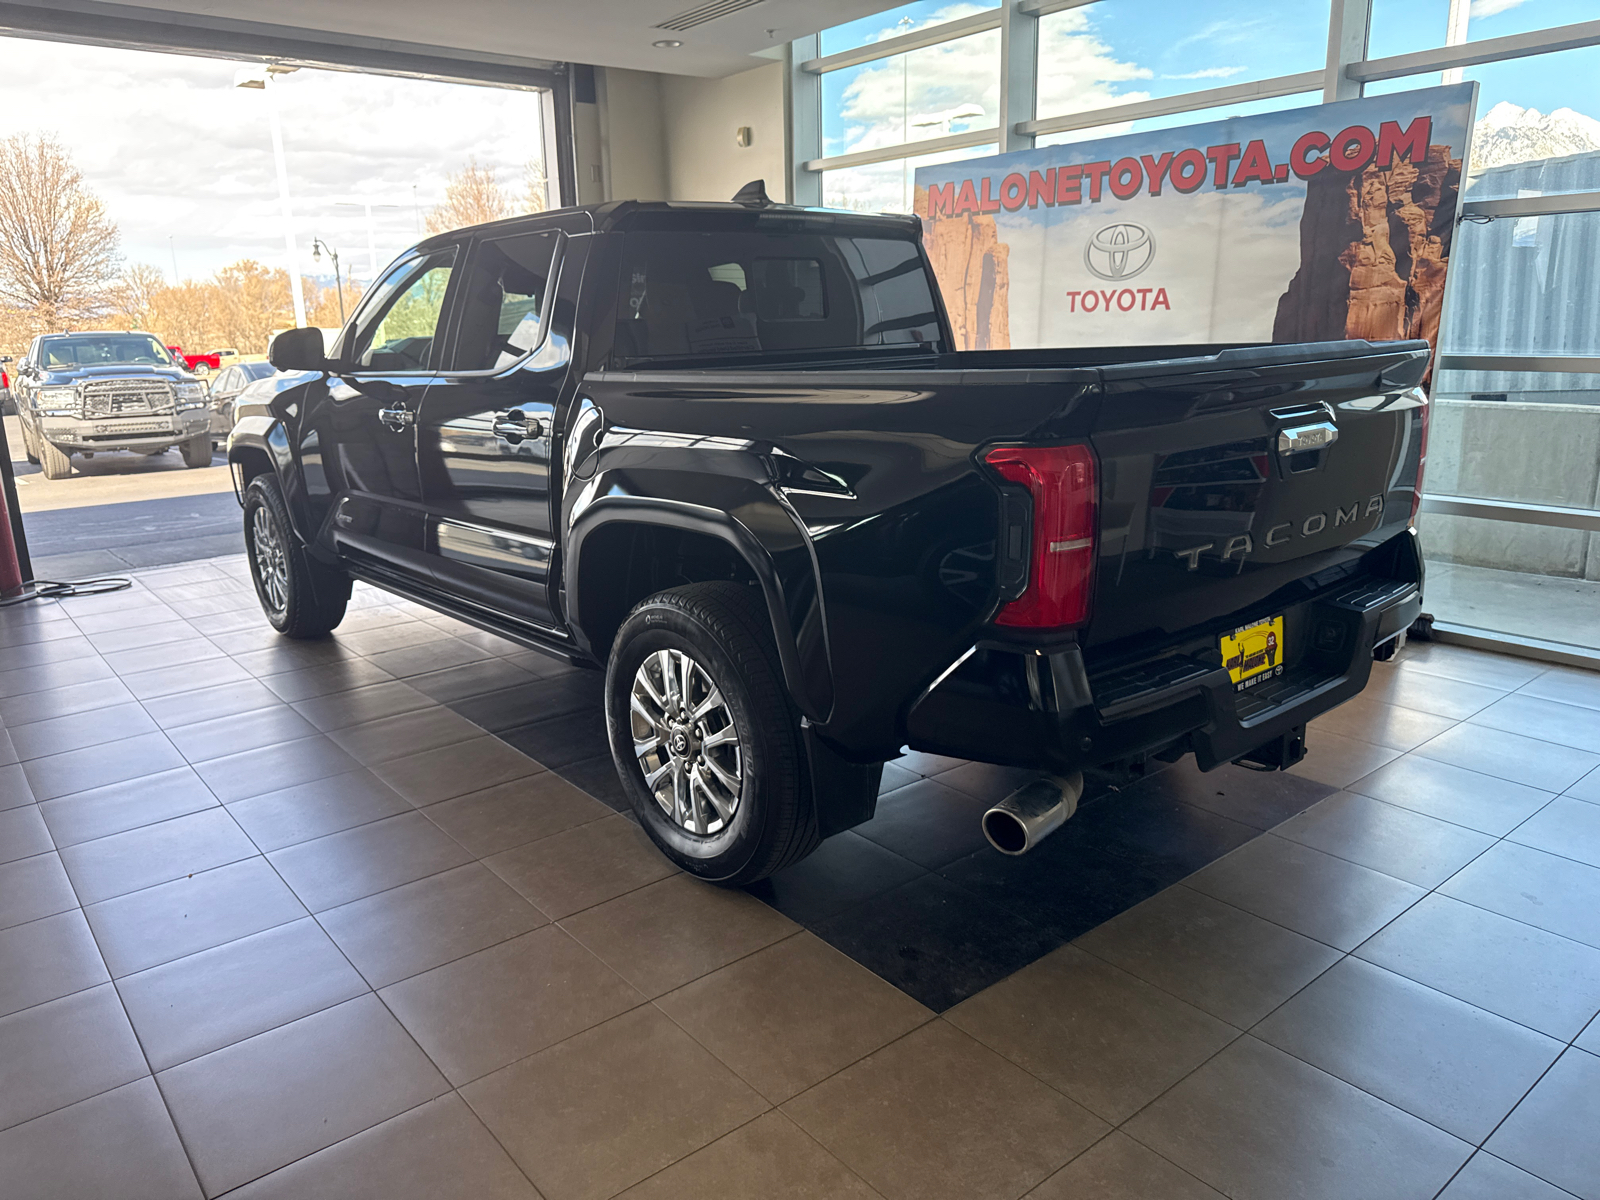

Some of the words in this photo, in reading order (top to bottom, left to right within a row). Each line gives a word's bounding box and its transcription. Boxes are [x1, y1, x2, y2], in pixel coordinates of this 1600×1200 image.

[927, 115, 1434, 218] MALONETOYOTA.COM
[1066, 287, 1172, 314] TOYOTA
[1174, 493, 1385, 572] TACOMA
[1267, 635, 1275, 646] 32
[1237, 682, 1245, 692] WE
[1245, 676, 1257, 689] MAKE
[1257, 674, 1262, 683] IT
[1262, 669, 1273, 681] EASY
